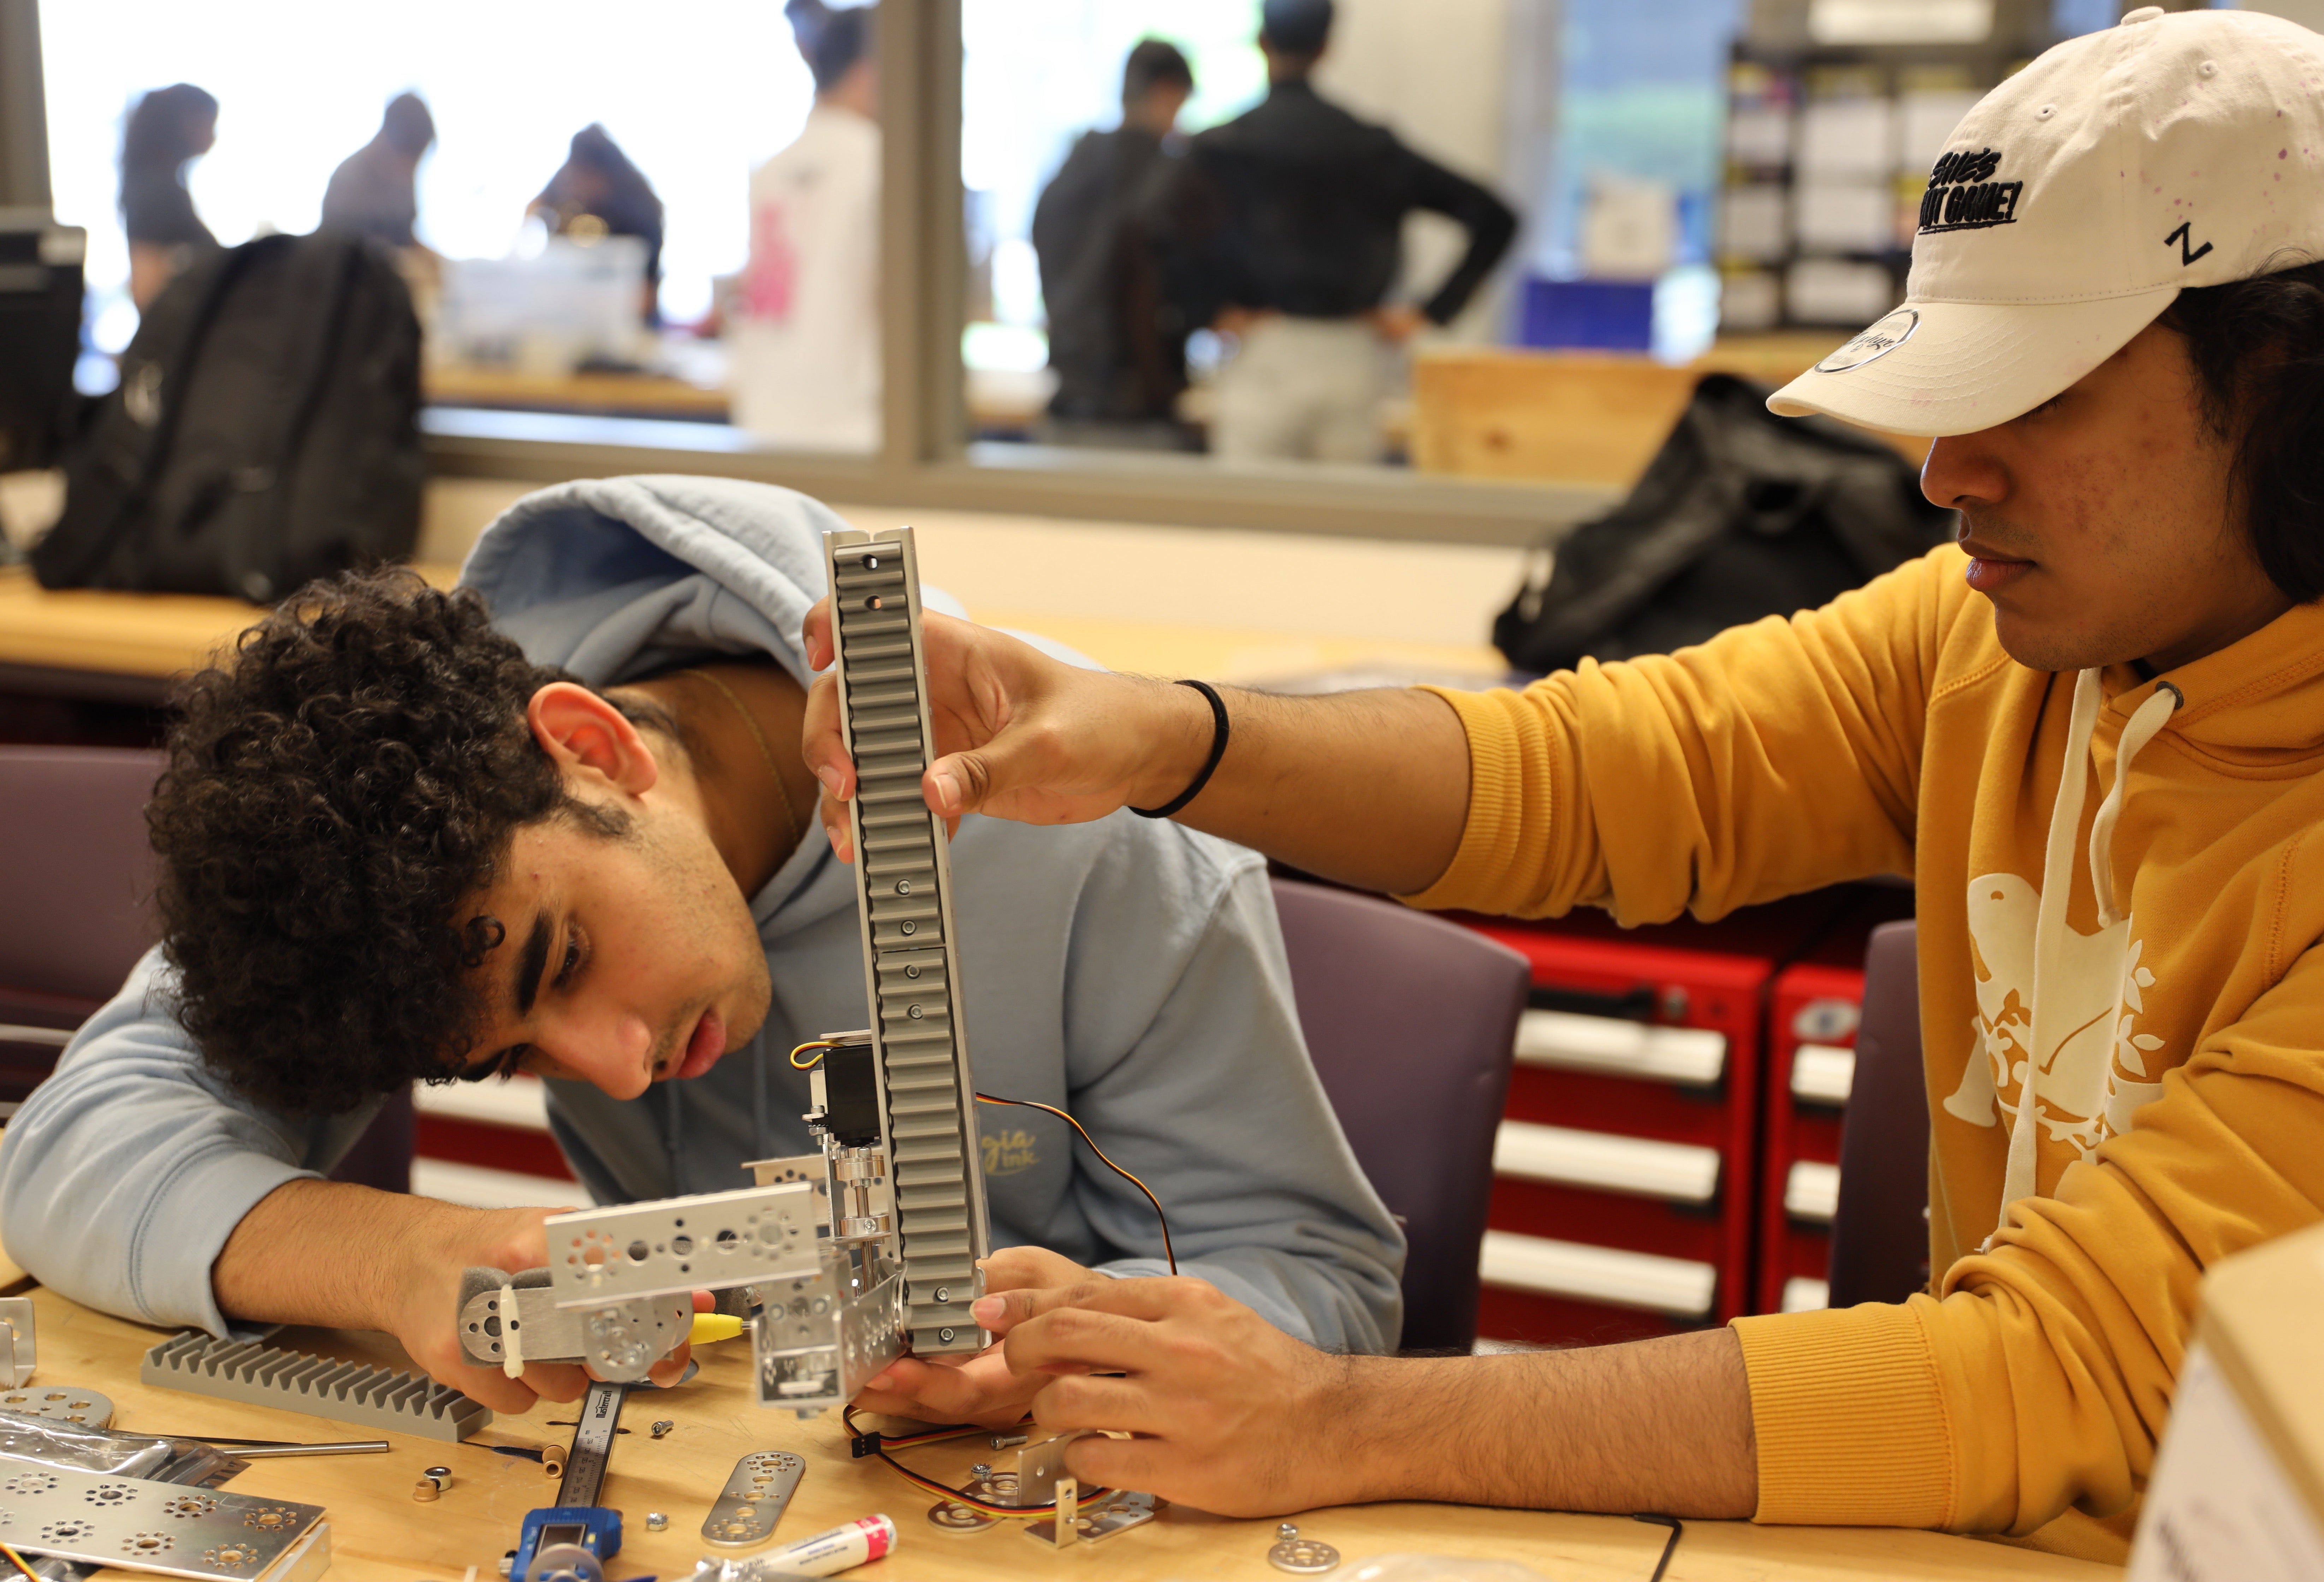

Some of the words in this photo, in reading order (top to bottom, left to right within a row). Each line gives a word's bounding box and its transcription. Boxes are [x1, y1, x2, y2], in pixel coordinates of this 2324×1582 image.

[1944, 180, 2023, 224] GAME!
[2164, 221, 2214, 267] Z
[595, 1391, 612, 1418] Mastercraft
